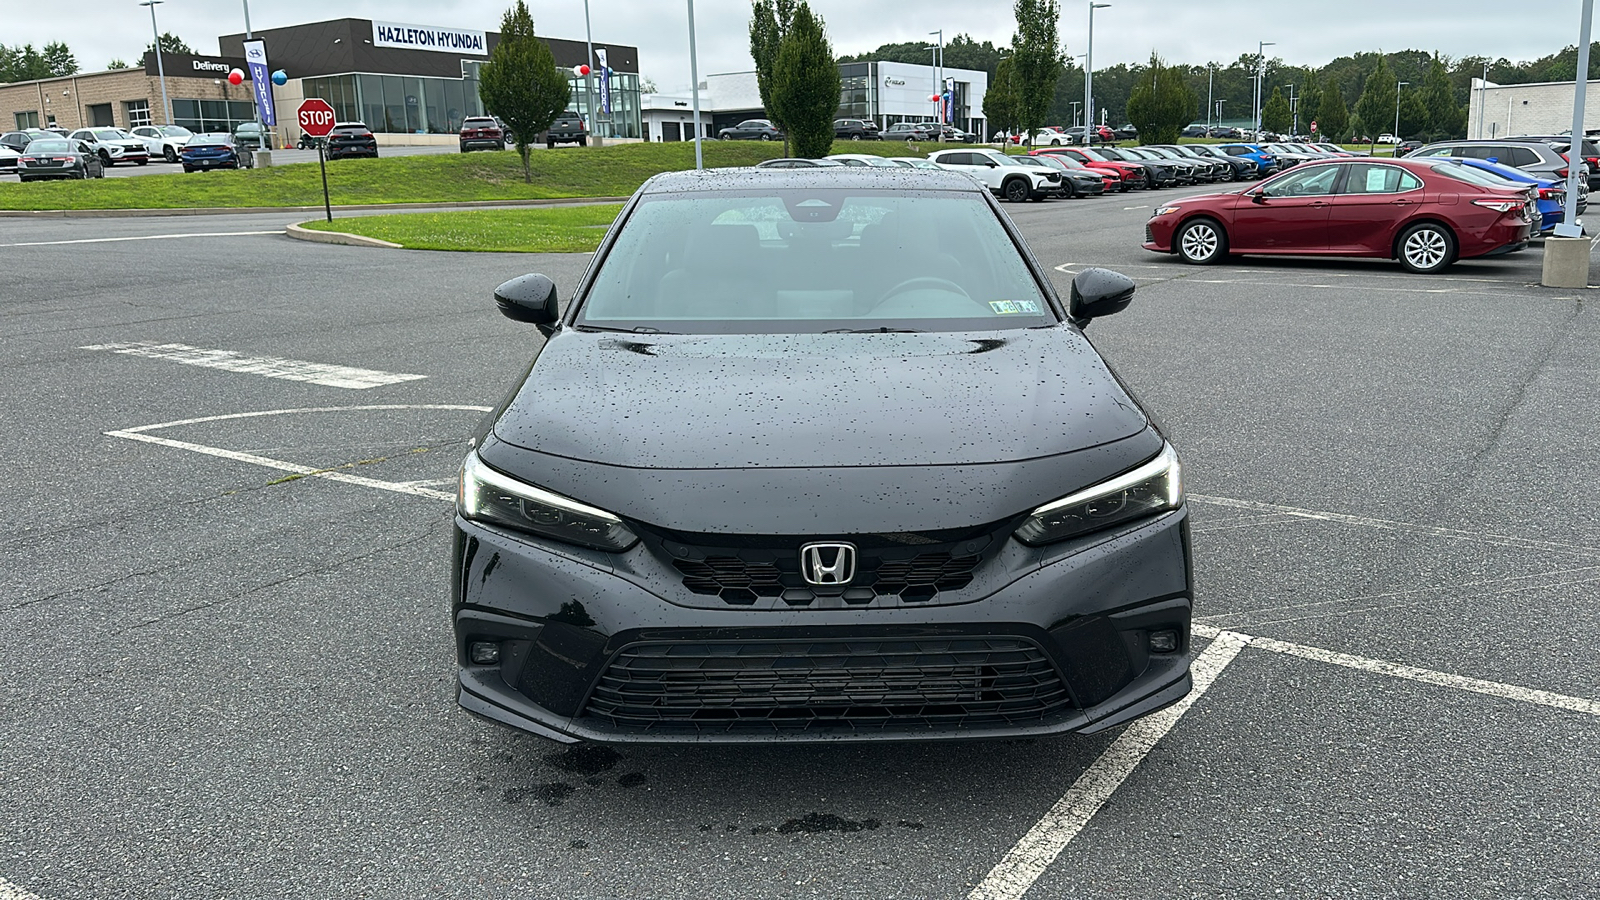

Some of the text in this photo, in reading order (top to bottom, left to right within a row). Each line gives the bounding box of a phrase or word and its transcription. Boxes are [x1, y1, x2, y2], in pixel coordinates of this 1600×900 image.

[377, 25, 483, 50] HAZLETON HYUNDAI
[192, 60, 230, 74] Delivery
[254, 66, 271, 123] HYUNDAI
[300, 110, 333, 125] STOP
